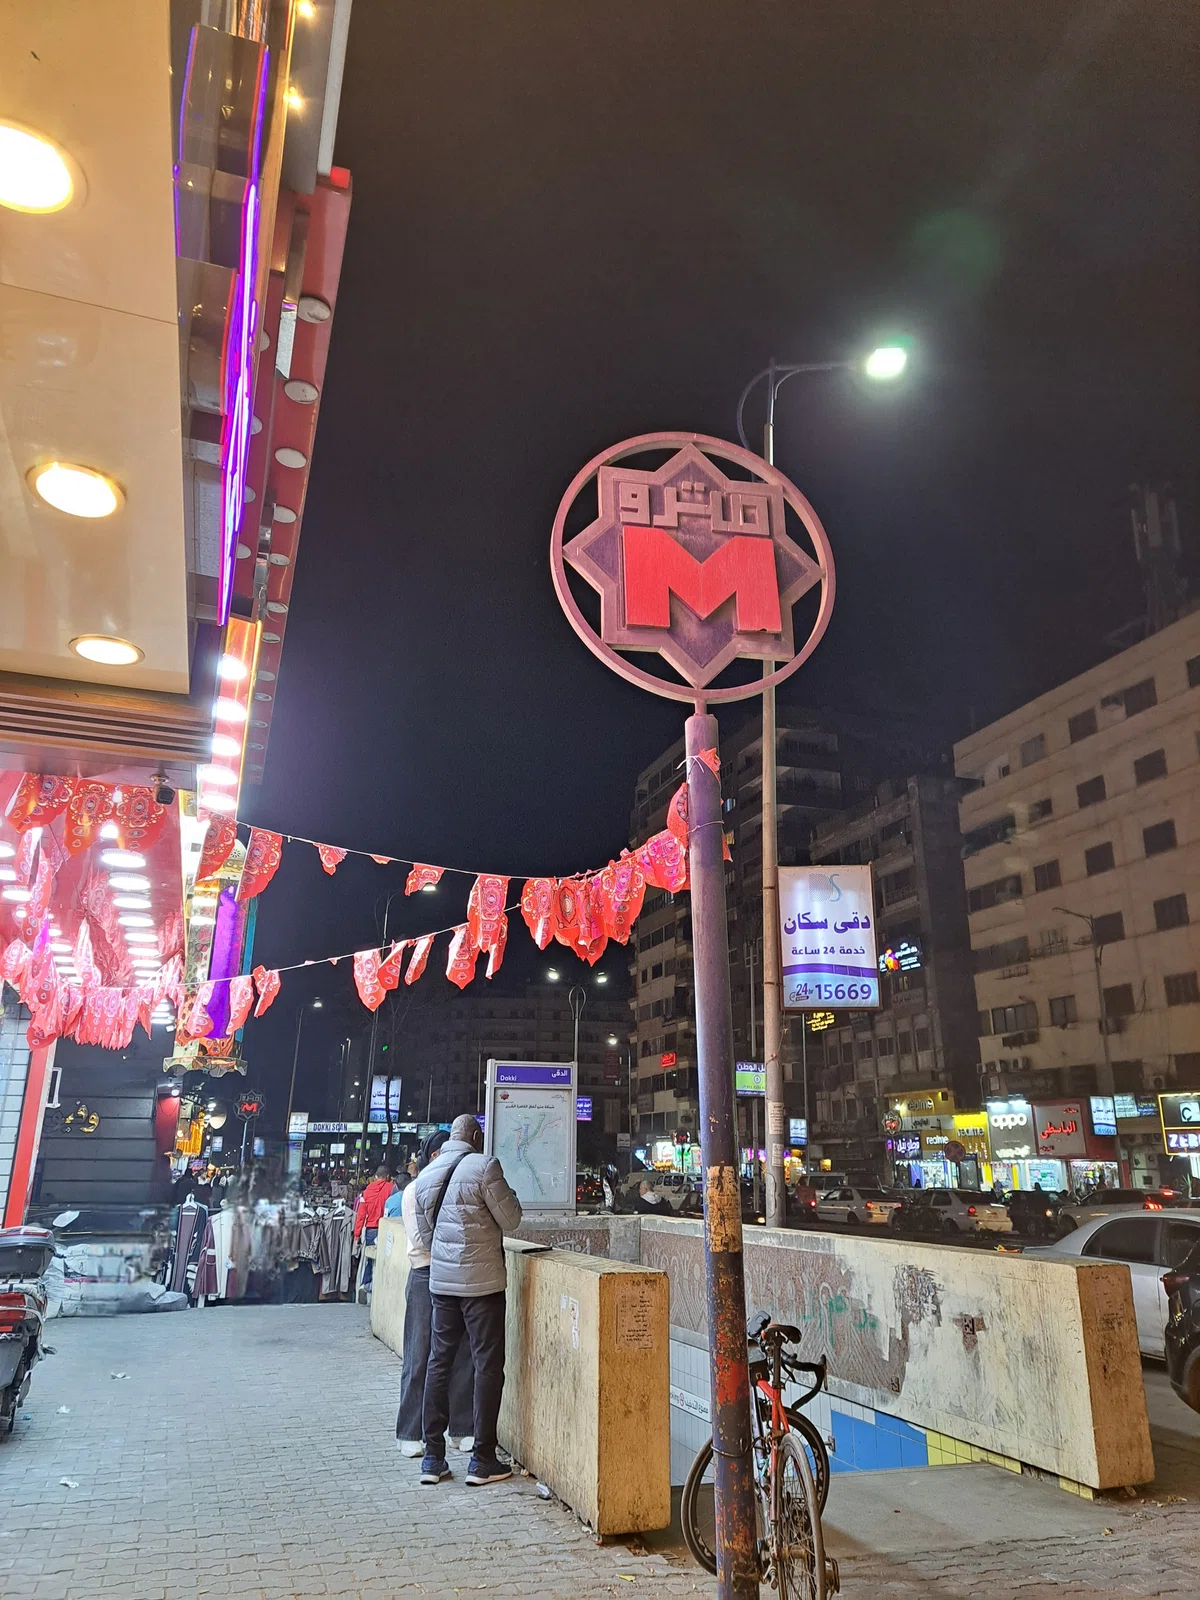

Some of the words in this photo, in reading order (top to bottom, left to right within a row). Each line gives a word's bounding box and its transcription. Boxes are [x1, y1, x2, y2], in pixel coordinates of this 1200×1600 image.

[619, 481, 770, 536] مترو
[622, 525, 783, 635] M
[783, 911, 829, 935] سكان
[833, 911, 871, 934] دقى
[791, 945, 821, 955] ساعة
[823, 946, 836, 955] 24
[839, 945, 866, 955] خدمة
[815, 983, 873, 1000] 15669
[990, 1113, 1028, 1130] oppo
[926, 1135, 949, 1145] realme
[957, 1127, 985, 1137] realme
